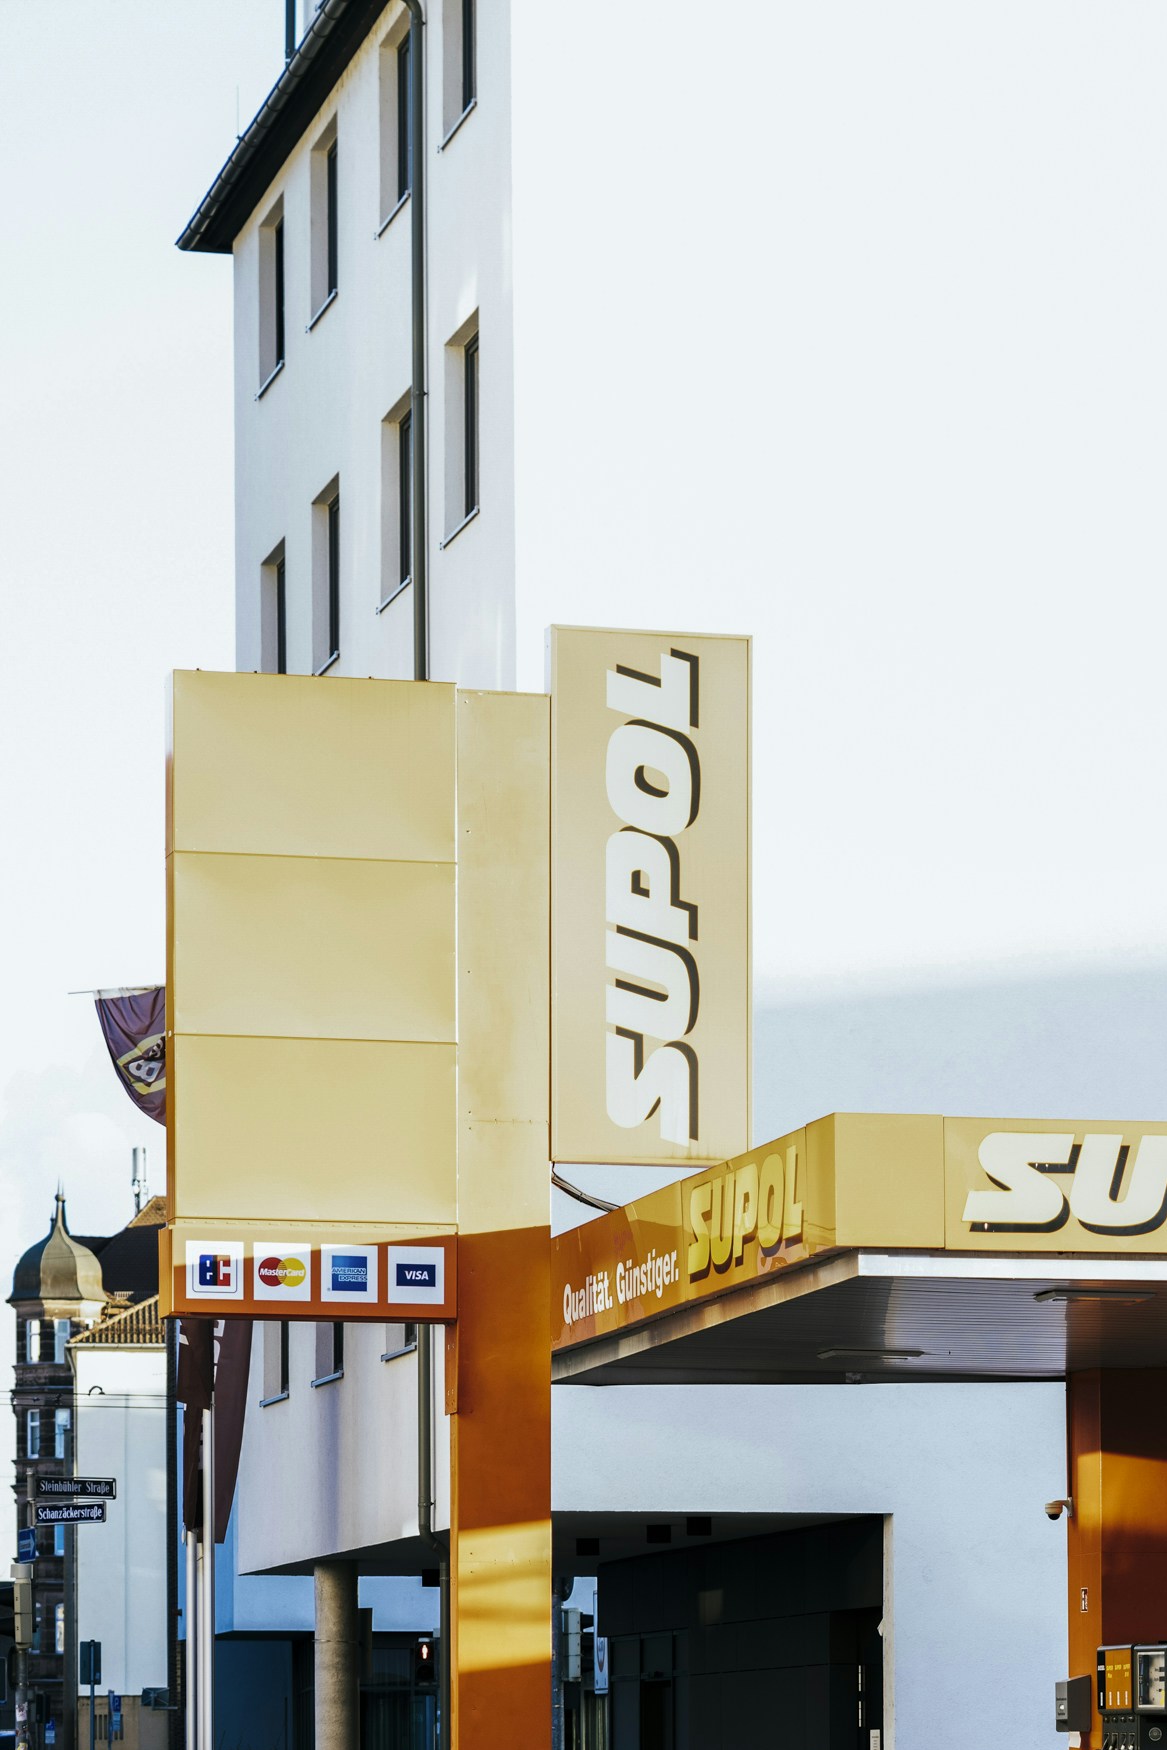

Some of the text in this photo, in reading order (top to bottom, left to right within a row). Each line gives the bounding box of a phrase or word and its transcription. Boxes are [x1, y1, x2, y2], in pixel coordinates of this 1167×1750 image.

[606, 648, 700, 1147] SUPOL
[688, 1145, 804, 1284] SUPOL
[259, 1267, 305, 1277] MasterCard
[332, 1267, 367, 1275] AMERICAN
[404, 1270, 429, 1281] VISA
[339, 1275, 368, 1283] EXPRESS
[563, 1249, 679, 1326] Qualität. Günstiger.
[40, 1480, 110, 1494] Steinbühler Straße
[38, 1505, 102, 1520] Schanzäckerstraße
